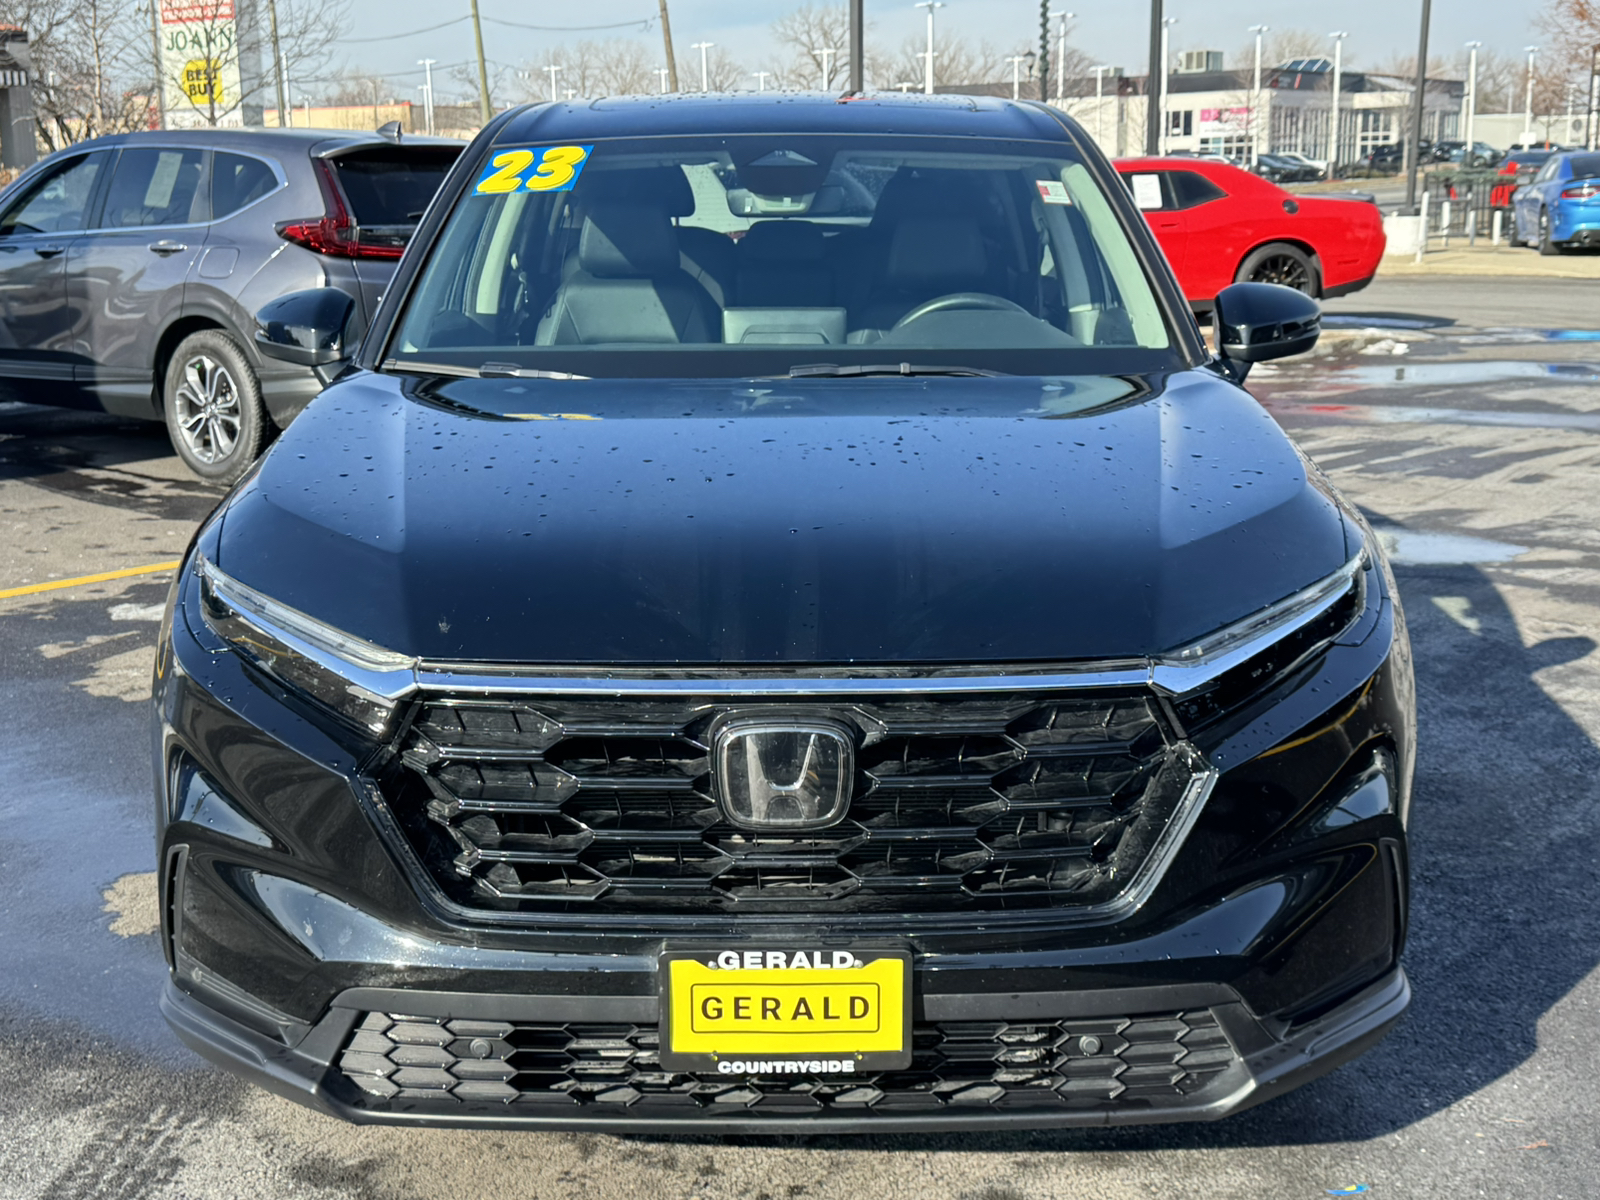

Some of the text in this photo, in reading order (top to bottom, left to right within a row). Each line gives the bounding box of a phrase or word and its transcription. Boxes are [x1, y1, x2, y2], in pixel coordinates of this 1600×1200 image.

[476, 145, 586, 194] 23
[717, 951, 855, 969] GERALD
[701, 996, 869, 1021] GERALD
[717, 1060, 855, 1074] COUNTRYSIDE
